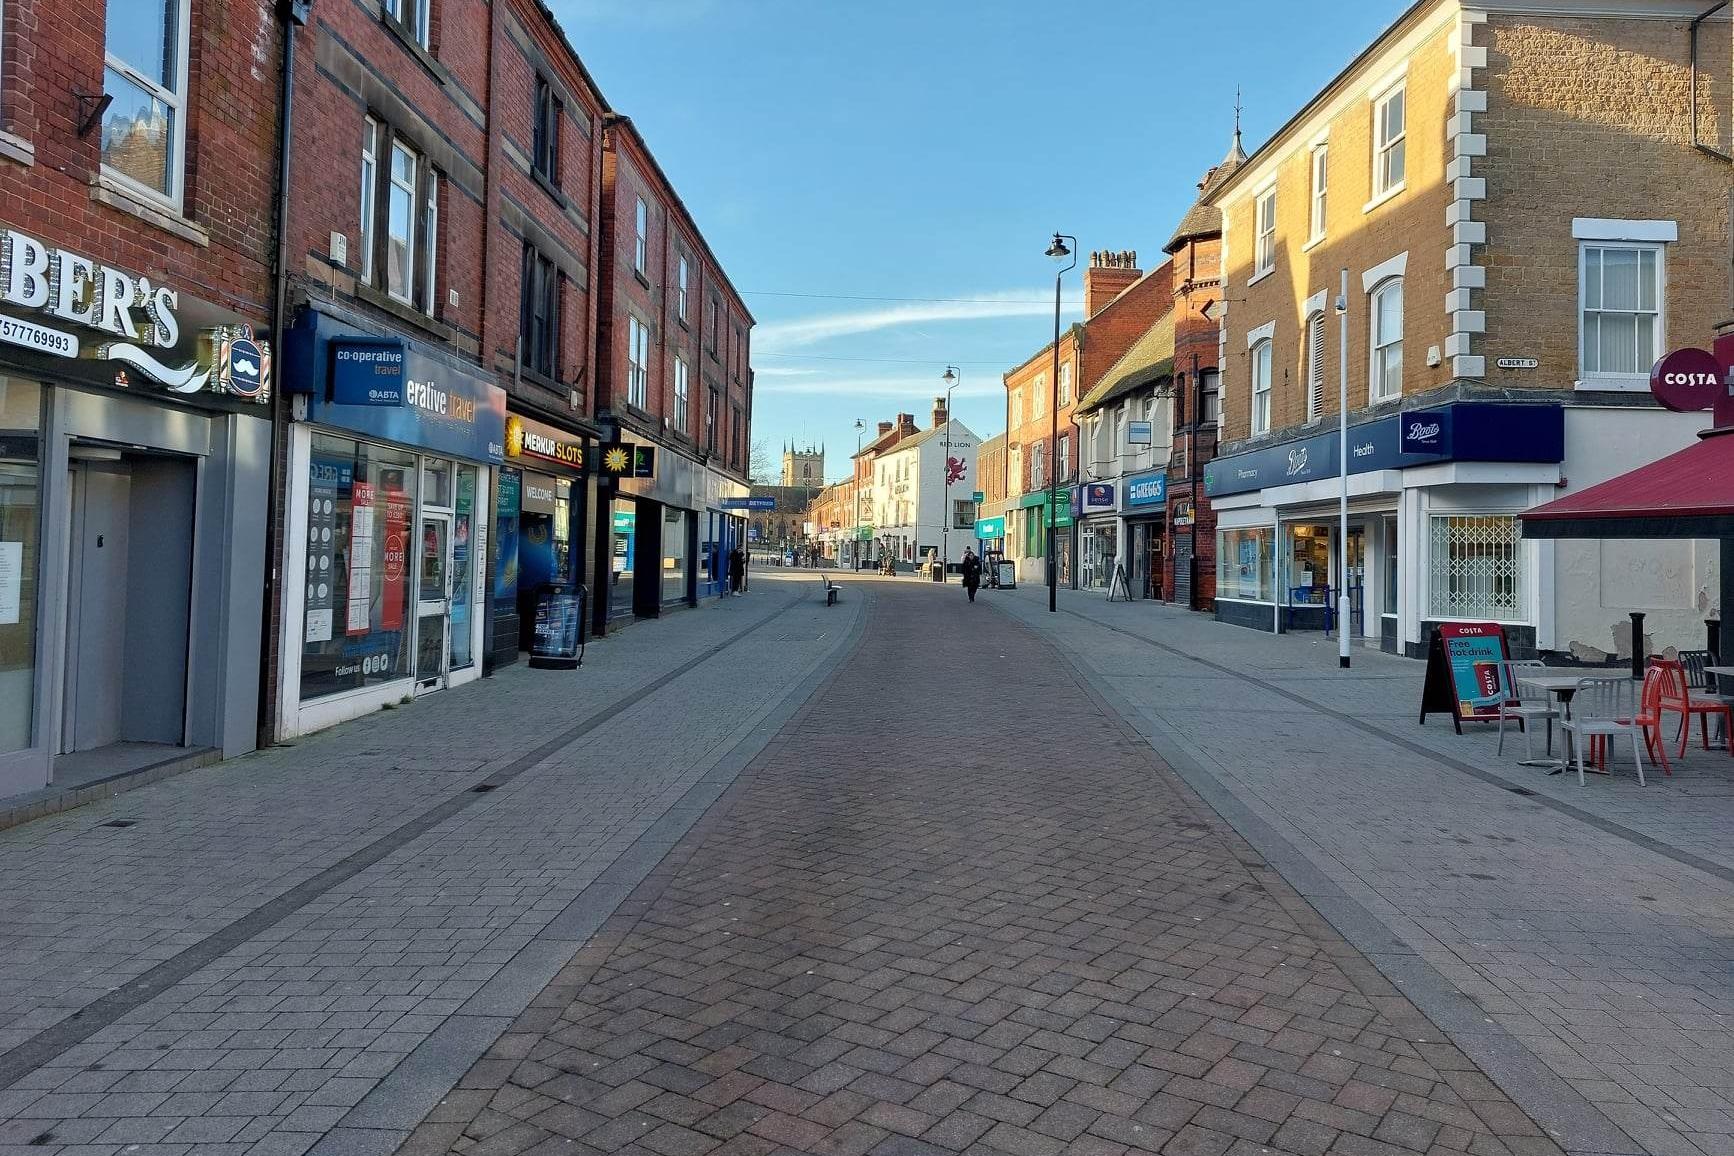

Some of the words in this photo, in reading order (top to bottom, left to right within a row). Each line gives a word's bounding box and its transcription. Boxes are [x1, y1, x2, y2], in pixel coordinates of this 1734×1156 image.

[0, 320, 69, 351] 577769993
[375, 364, 401, 375] travel
[1664, 373, 1717, 387] COSTA
[377, 391, 399, 399] ABTA
[407, 380, 447, 415] erative
[449, 391, 476, 423] travel
[1406, 422, 1440, 440] Boots
[524, 431, 556, 457] MERKUR
[556, 442, 583, 465] SLOTS
[1353, 441, 1375, 458] Health
[1238, 468, 1259, 480] Pharmacy
[355, 488, 375, 500] MORE
[526, 485, 552, 501] WELCOME
[1136, 479, 1161, 500] GREGGS
[384, 552, 402, 562] MORE
[1448, 640, 1470, 648] Free
[1450, 648, 1467, 657] hot
[1468, 647, 1494, 656] drink
[335, 665, 354, 677] Follow
[1484, 669, 1494, 695] COSTA
